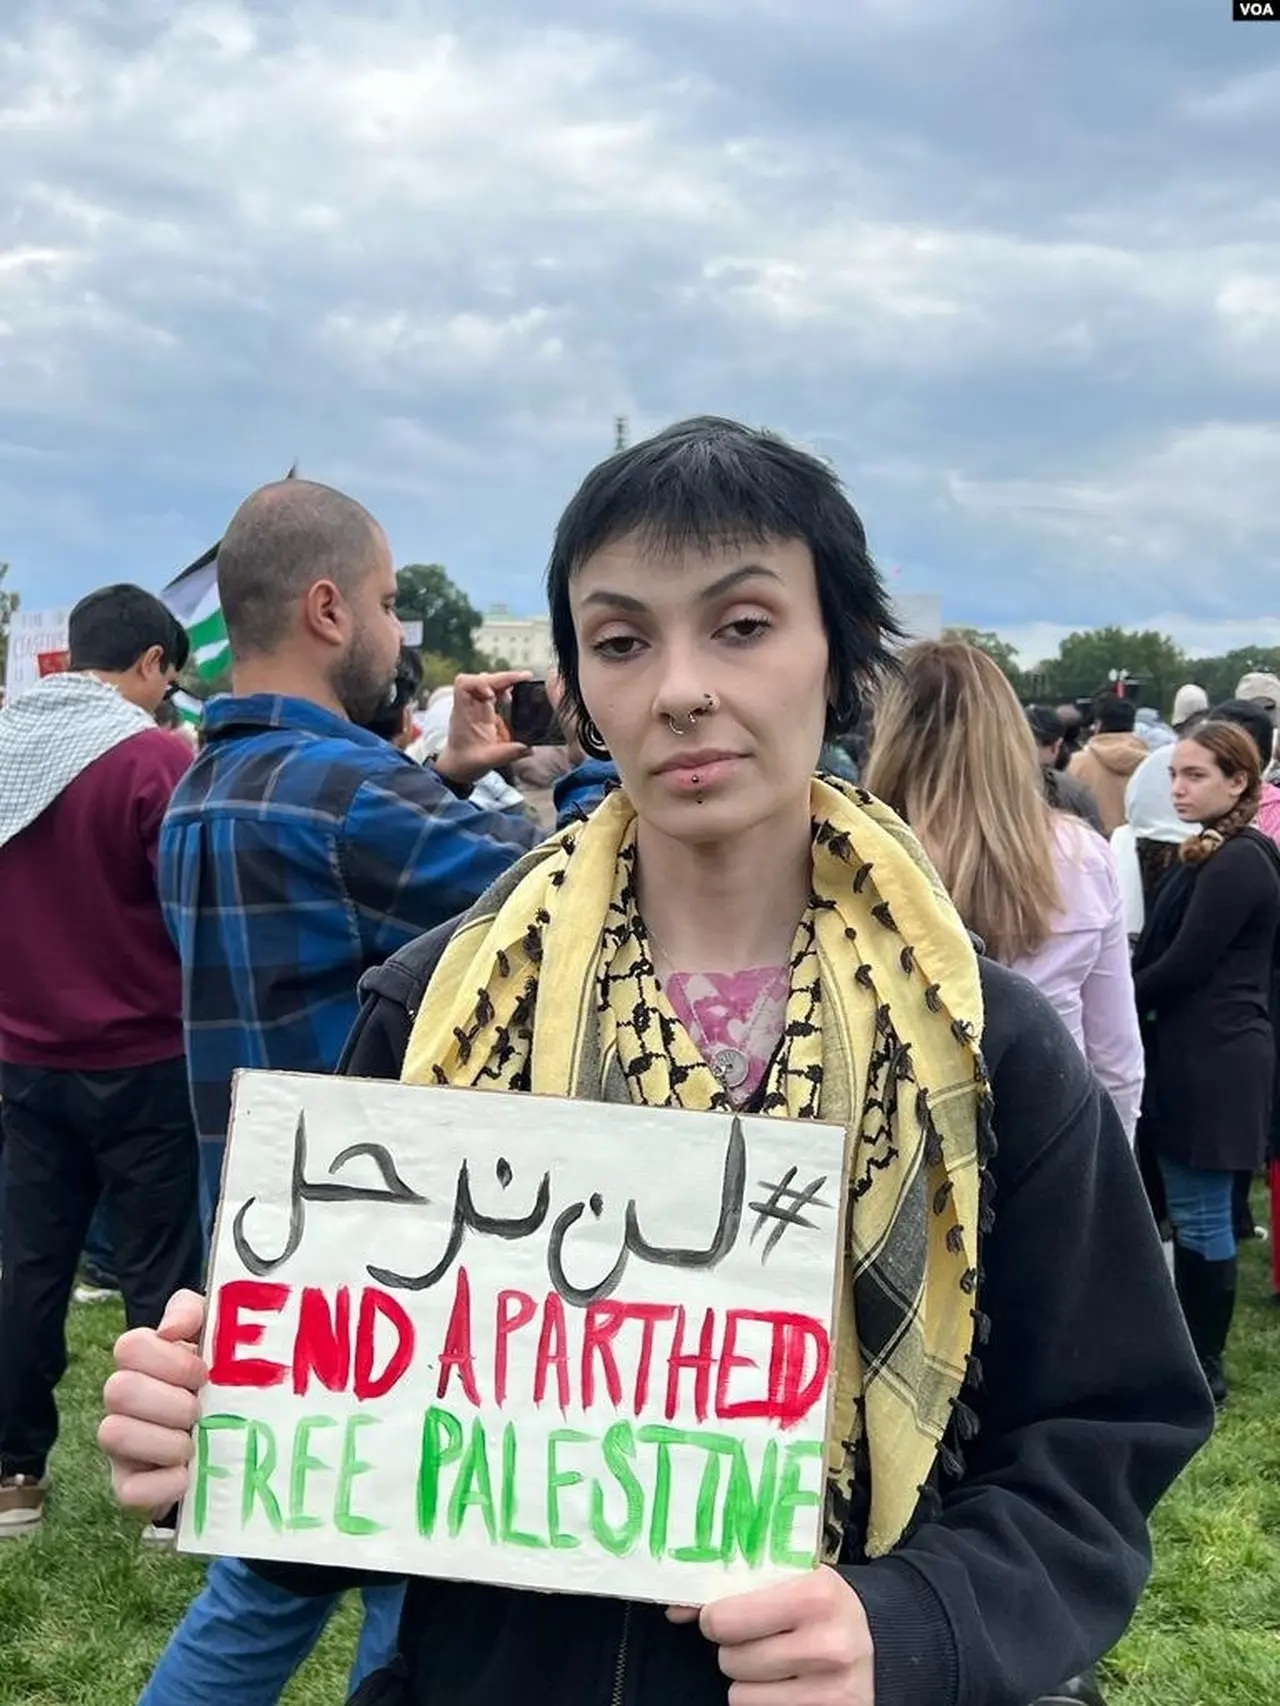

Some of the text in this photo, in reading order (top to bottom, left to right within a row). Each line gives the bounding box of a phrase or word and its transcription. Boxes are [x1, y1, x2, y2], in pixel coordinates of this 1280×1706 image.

[233, 1109, 551, 1291] نرحل
[208, 1280, 416, 1401] END
[195, 1405, 824, 1569] FREE PALESTINE
